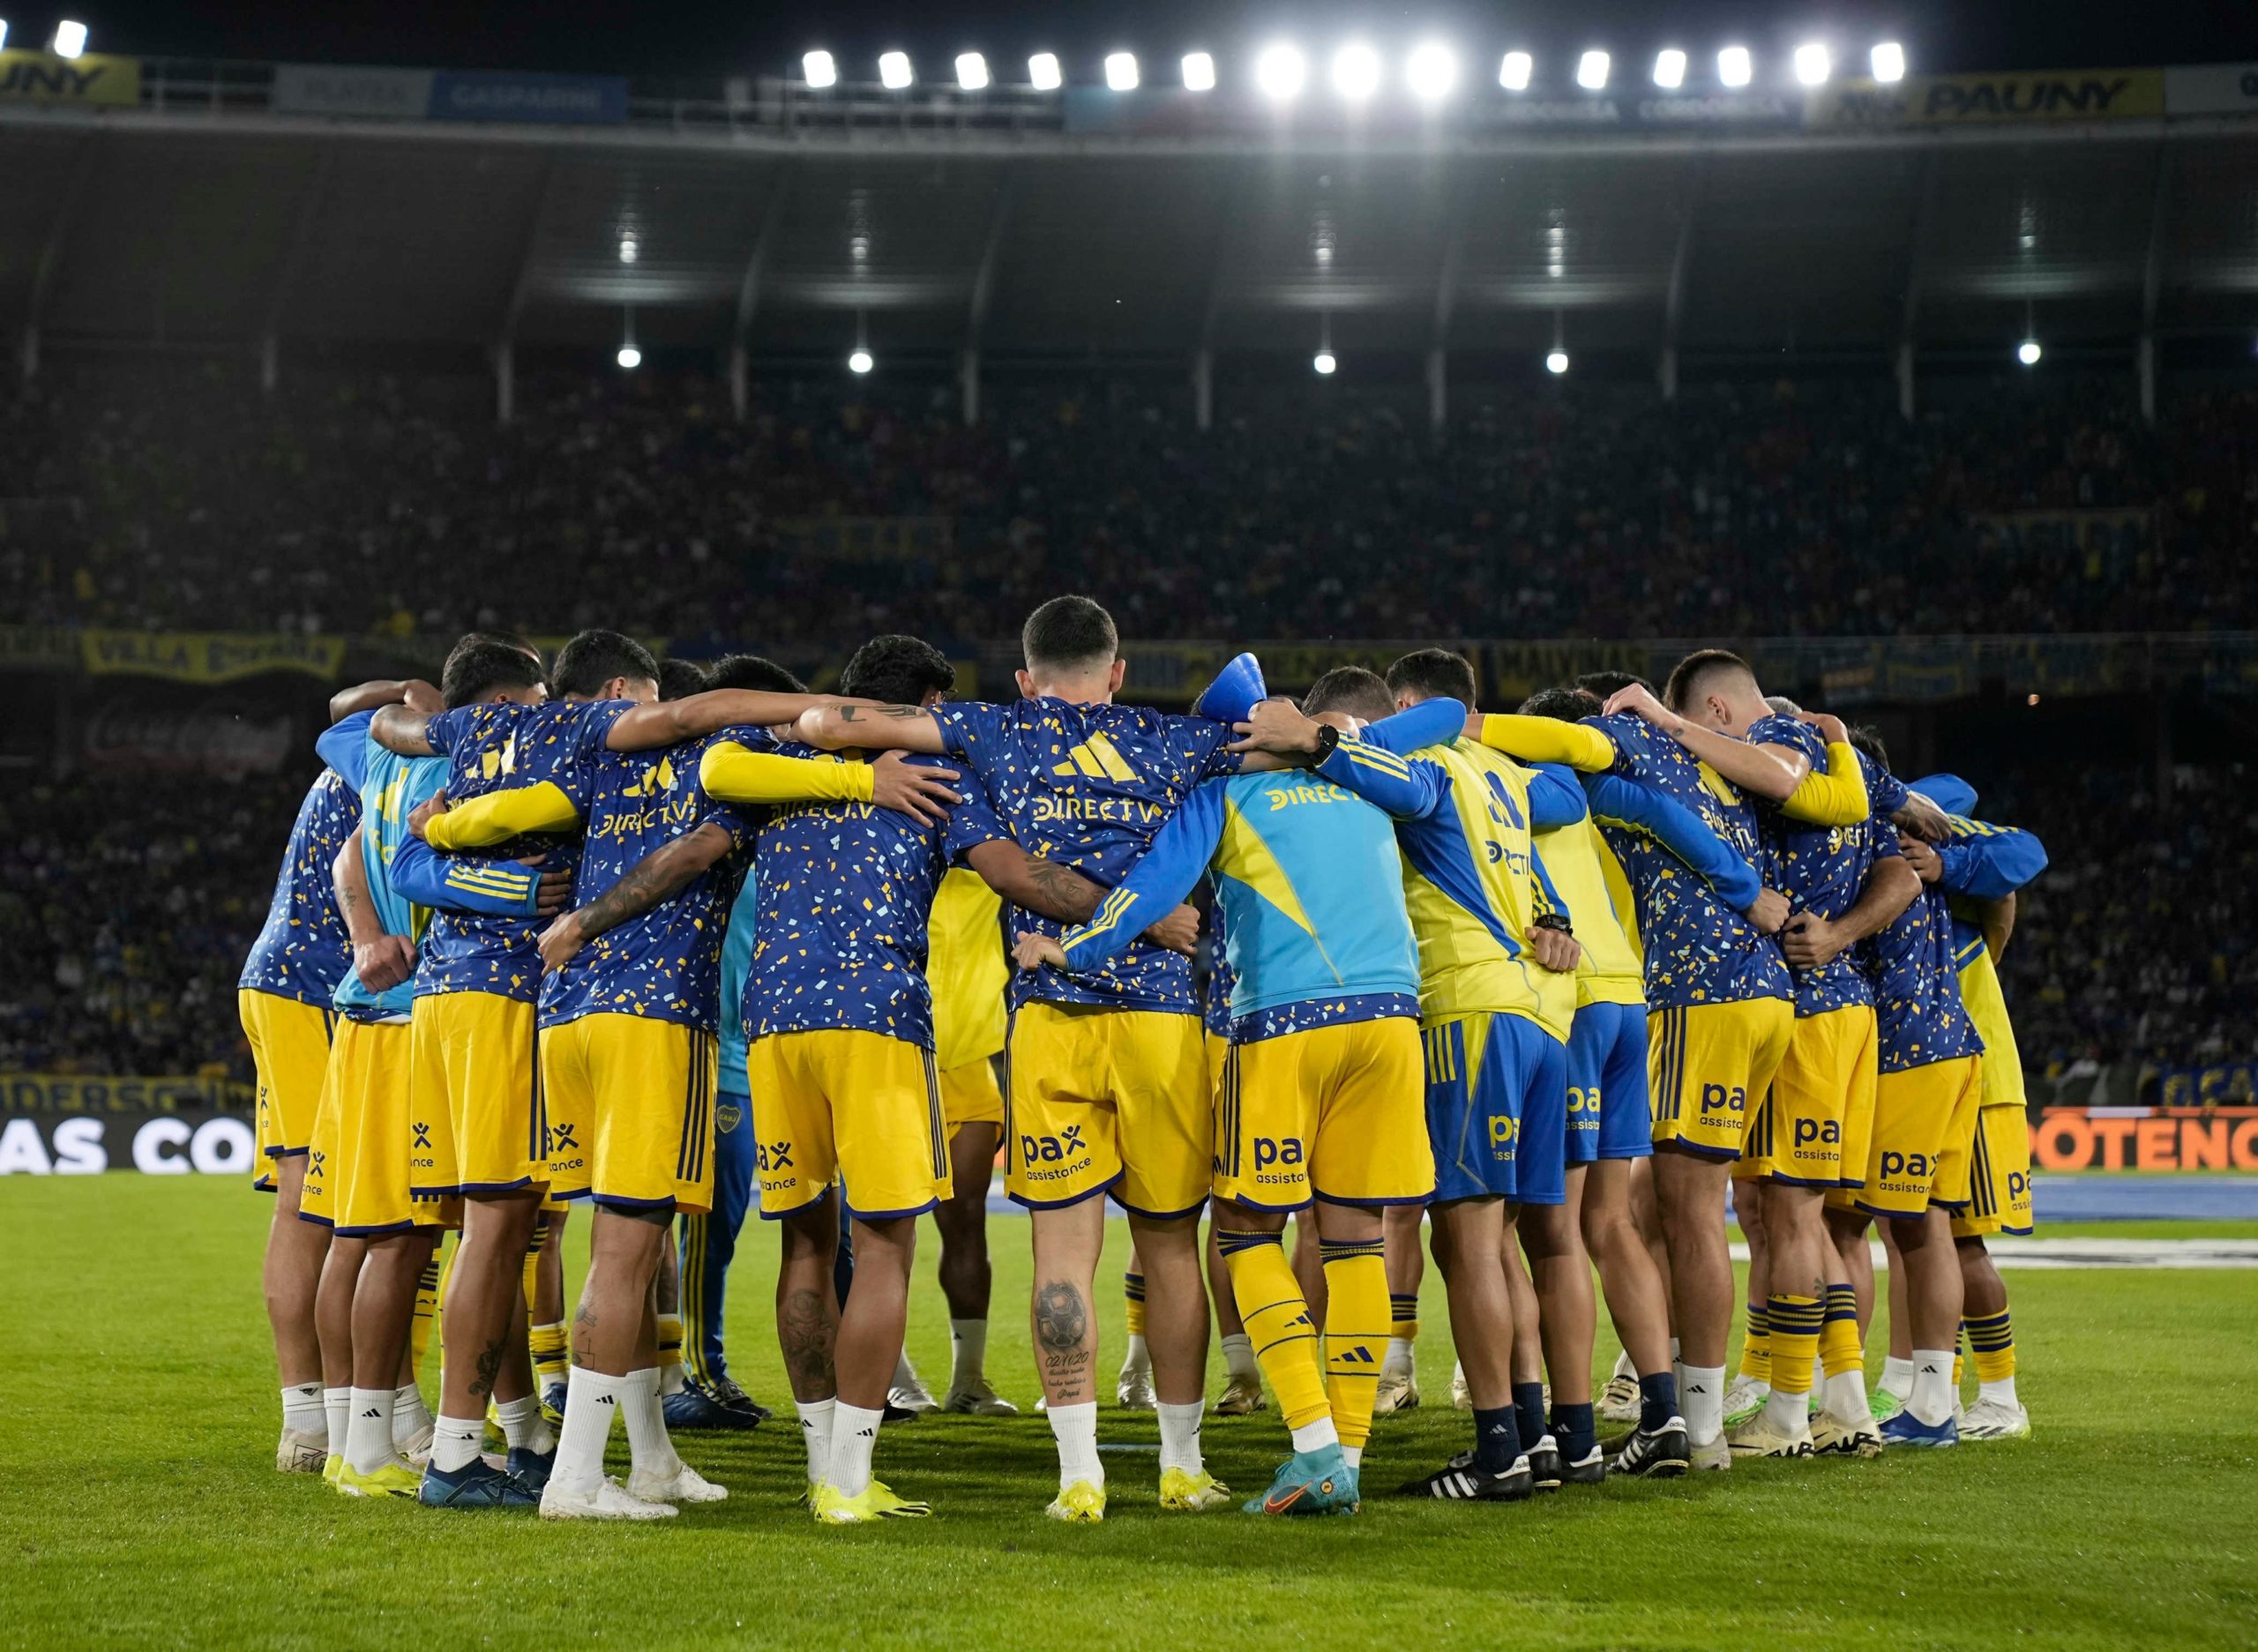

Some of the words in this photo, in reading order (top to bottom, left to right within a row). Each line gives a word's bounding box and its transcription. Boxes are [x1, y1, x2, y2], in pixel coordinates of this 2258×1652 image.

[1926, 78, 2129, 115] PAUNY
[1034, 796, 1157, 822] DIRECTV
[1269, 784, 1360, 811] DIREC
[0, 1118, 108, 1175] AS
[1254, 1137, 1305, 1171] pa
[2029, 1112, 2258, 1171] OTENC
[1027, 1156, 1091, 1180] assistance
[1257, 1172, 1306, 1184] assista
[1814, 1431, 1880, 1454] AIR
